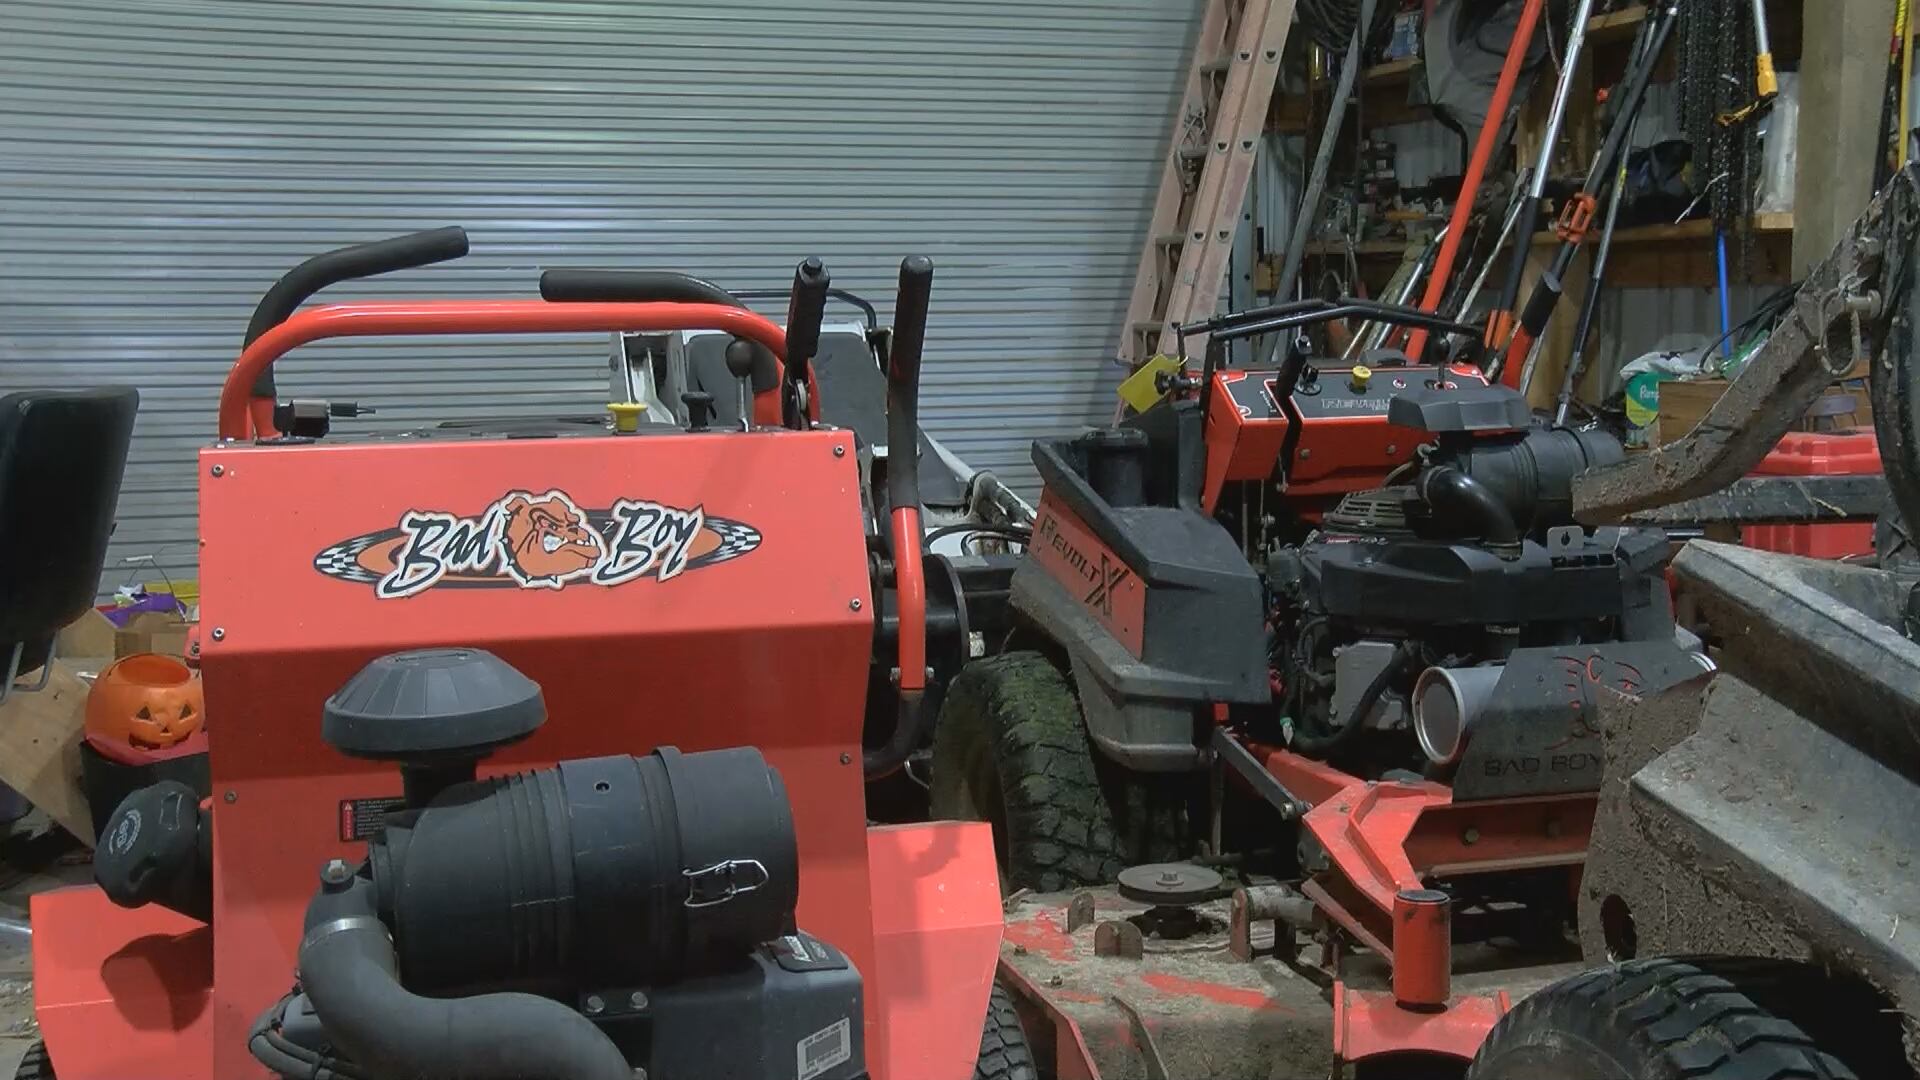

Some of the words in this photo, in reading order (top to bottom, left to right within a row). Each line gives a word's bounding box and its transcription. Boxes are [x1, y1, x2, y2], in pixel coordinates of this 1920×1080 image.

[380, 507, 499, 596] Bad
[594, 502, 702, 583] Boy
[1484, 757, 1540, 777] BAD
